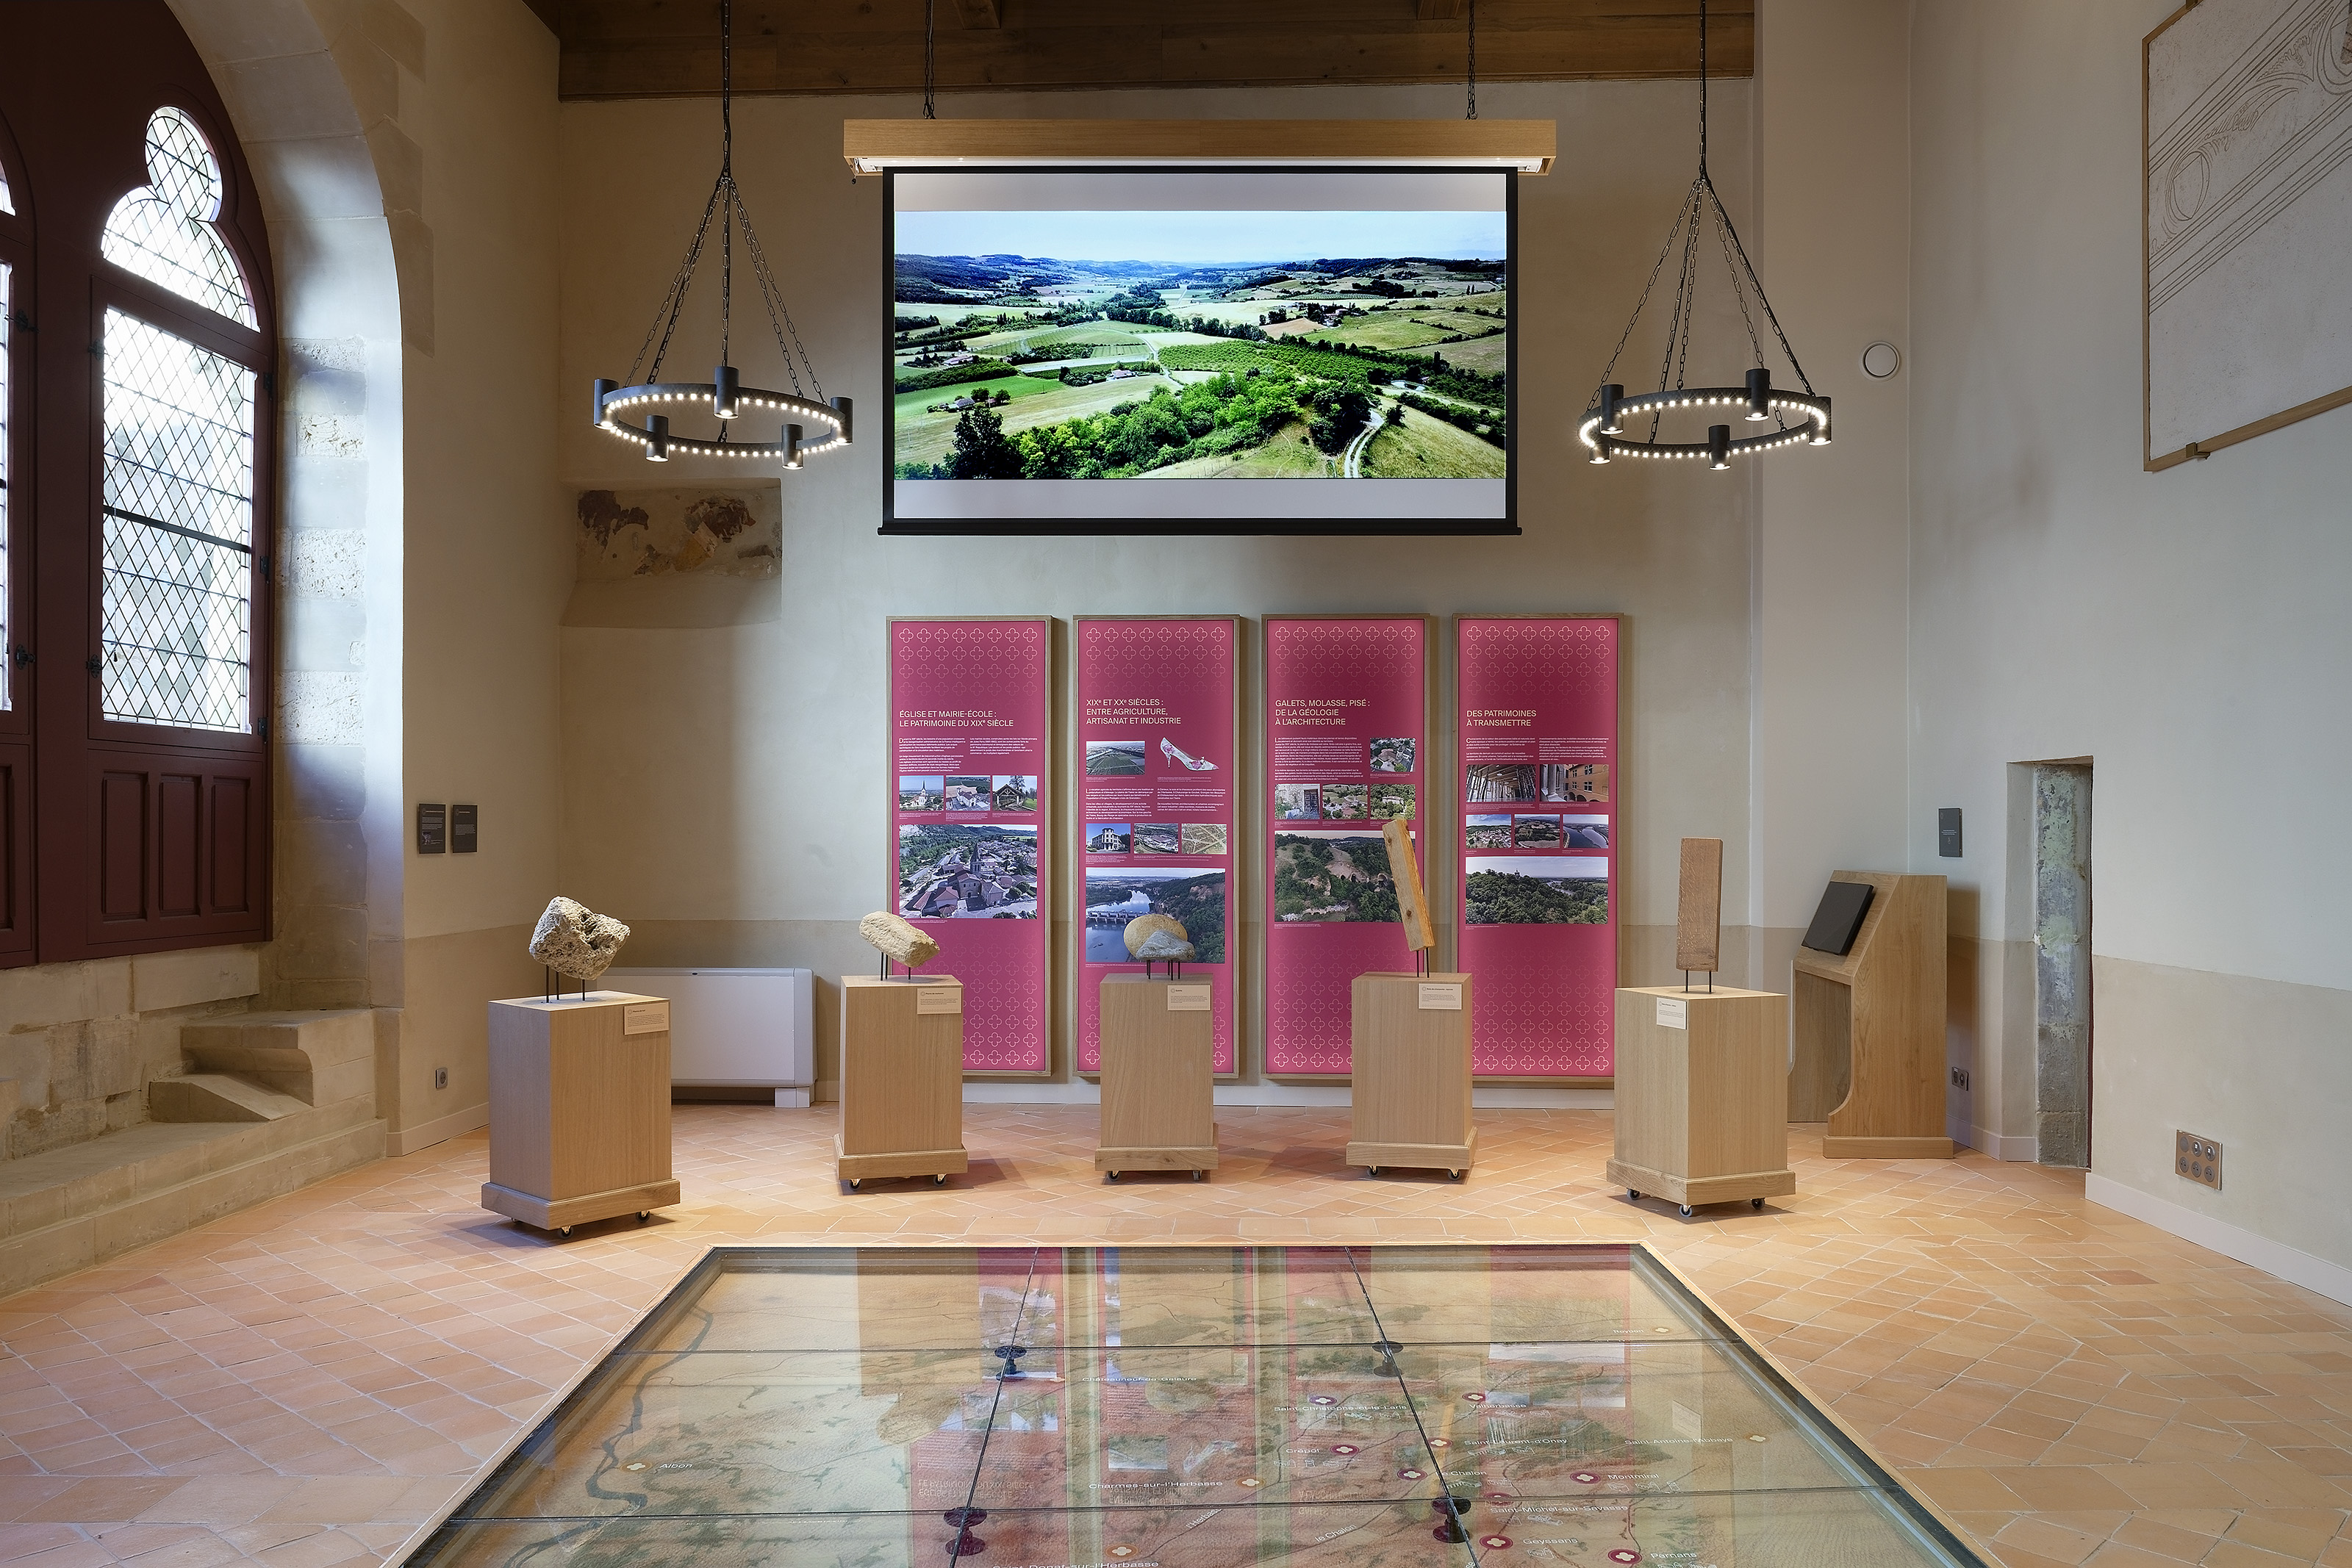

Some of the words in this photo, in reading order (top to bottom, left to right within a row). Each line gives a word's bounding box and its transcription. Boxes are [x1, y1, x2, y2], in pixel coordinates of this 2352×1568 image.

[1128, 698, 1160, 706] SIÈCLES
[1349, 699, 1366, 707] PISÉ
[900, 710, 927, 718] ÉGLISE
[939, 710, 993, 718] MAIRIE-ÉCOLE
[1299, 708, 1339, 716] GÉOLOGIE
[987, 719, 1014, 727] SIÈCLE
[1466, 719, 1472, 727] À
[1089, 1481, 1223, 1489] Charmes-sur-l'Herbasse
[1491, 1505, 1628, 1514] Saint-Michel-sur-Savasse
[1186, 1508, 1222, 1528] l'Herbass
[1325, 1524, 1357, 1538] Chalon
